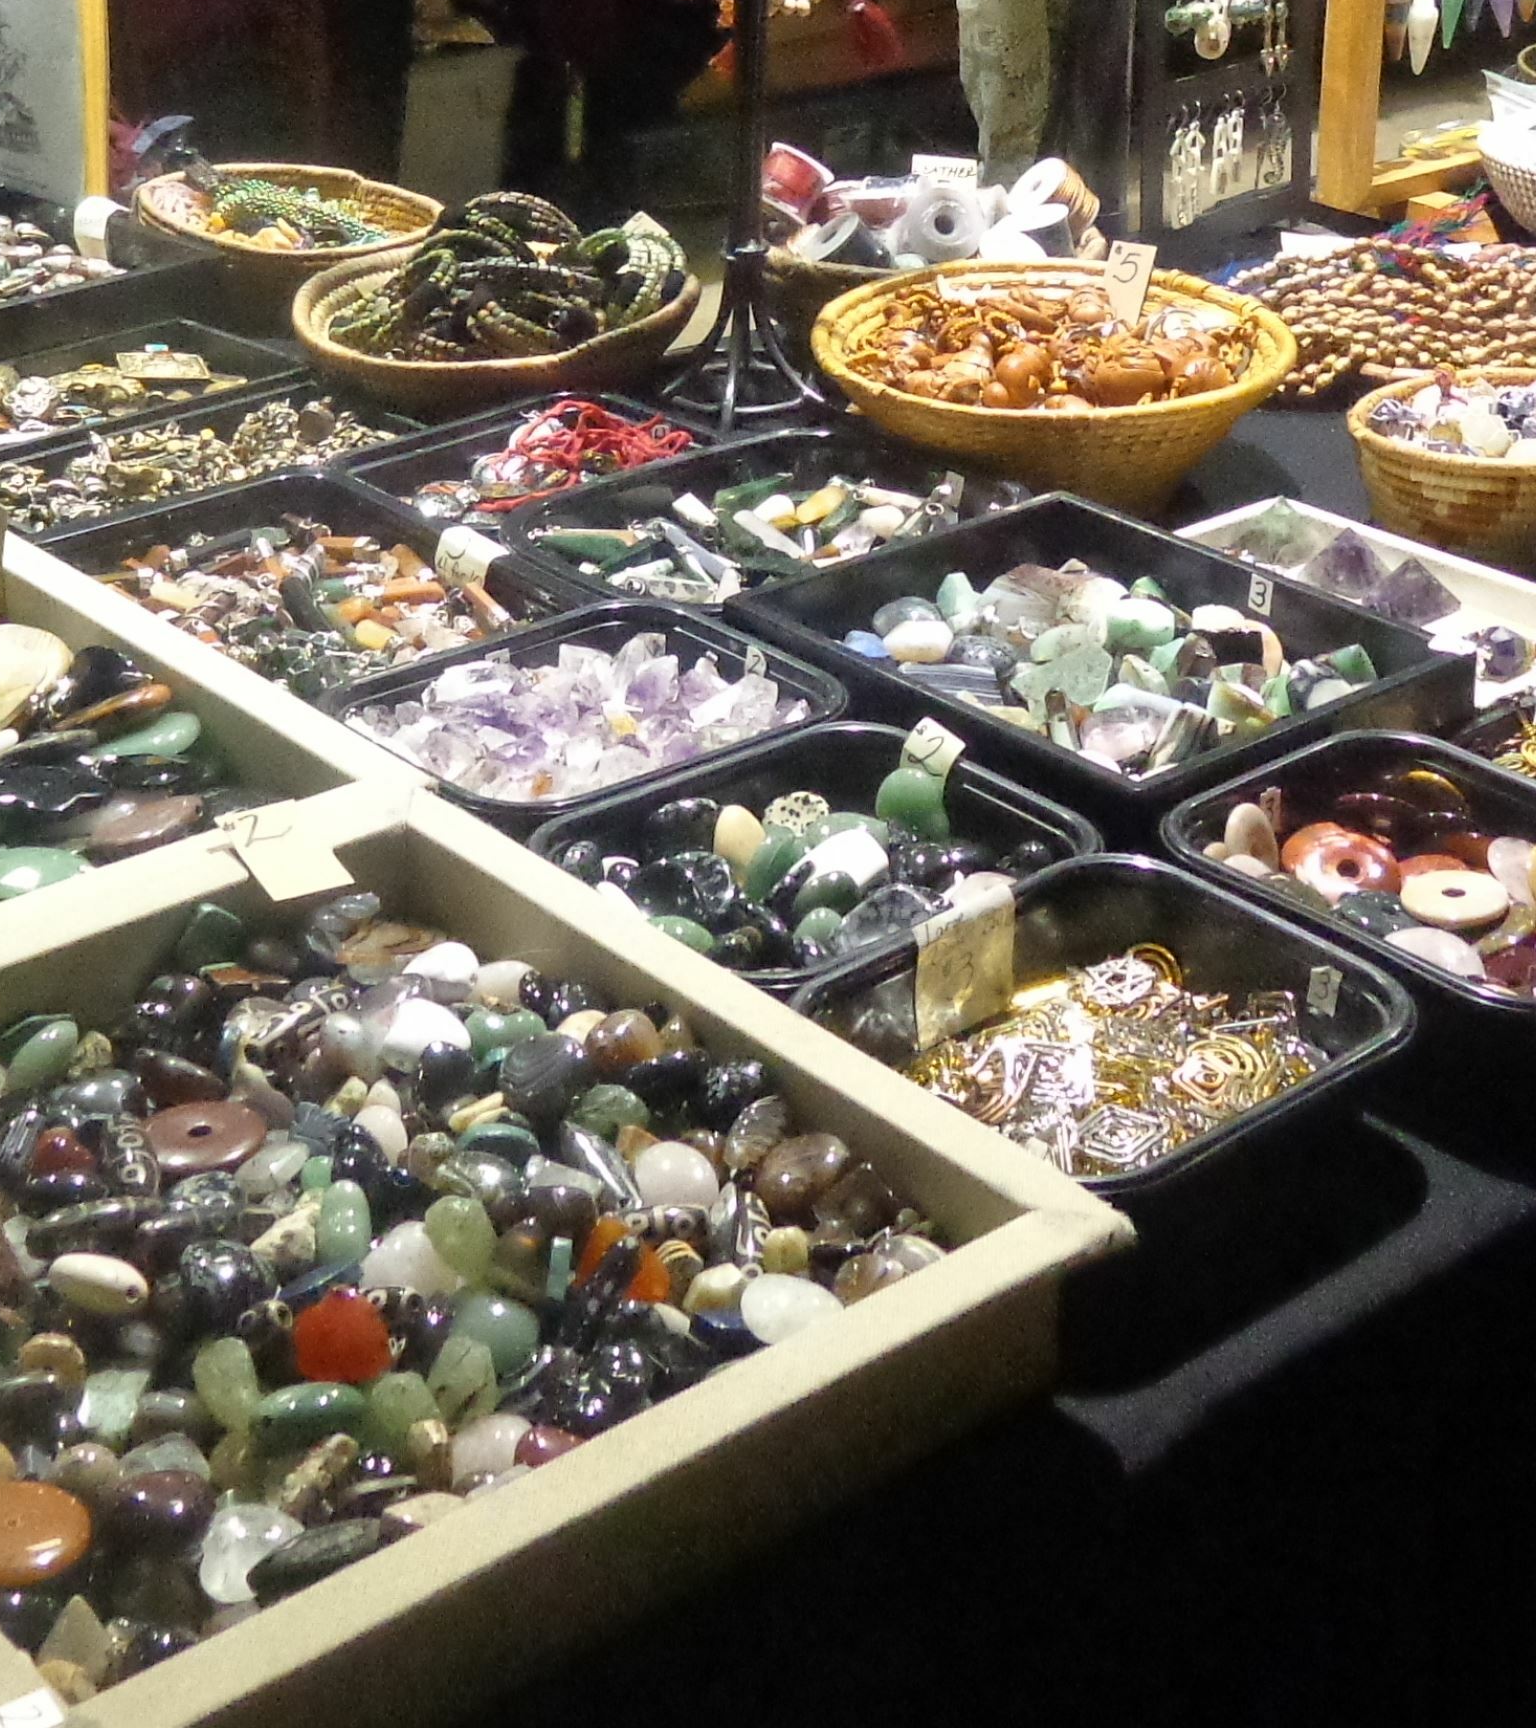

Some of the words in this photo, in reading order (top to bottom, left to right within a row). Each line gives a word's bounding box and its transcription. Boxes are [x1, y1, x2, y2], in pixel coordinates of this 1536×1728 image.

[1250, 580, 1268, 608] 3
[747, 655, 761, 673] 2
[1313, 971, 1332, 1001] 3
